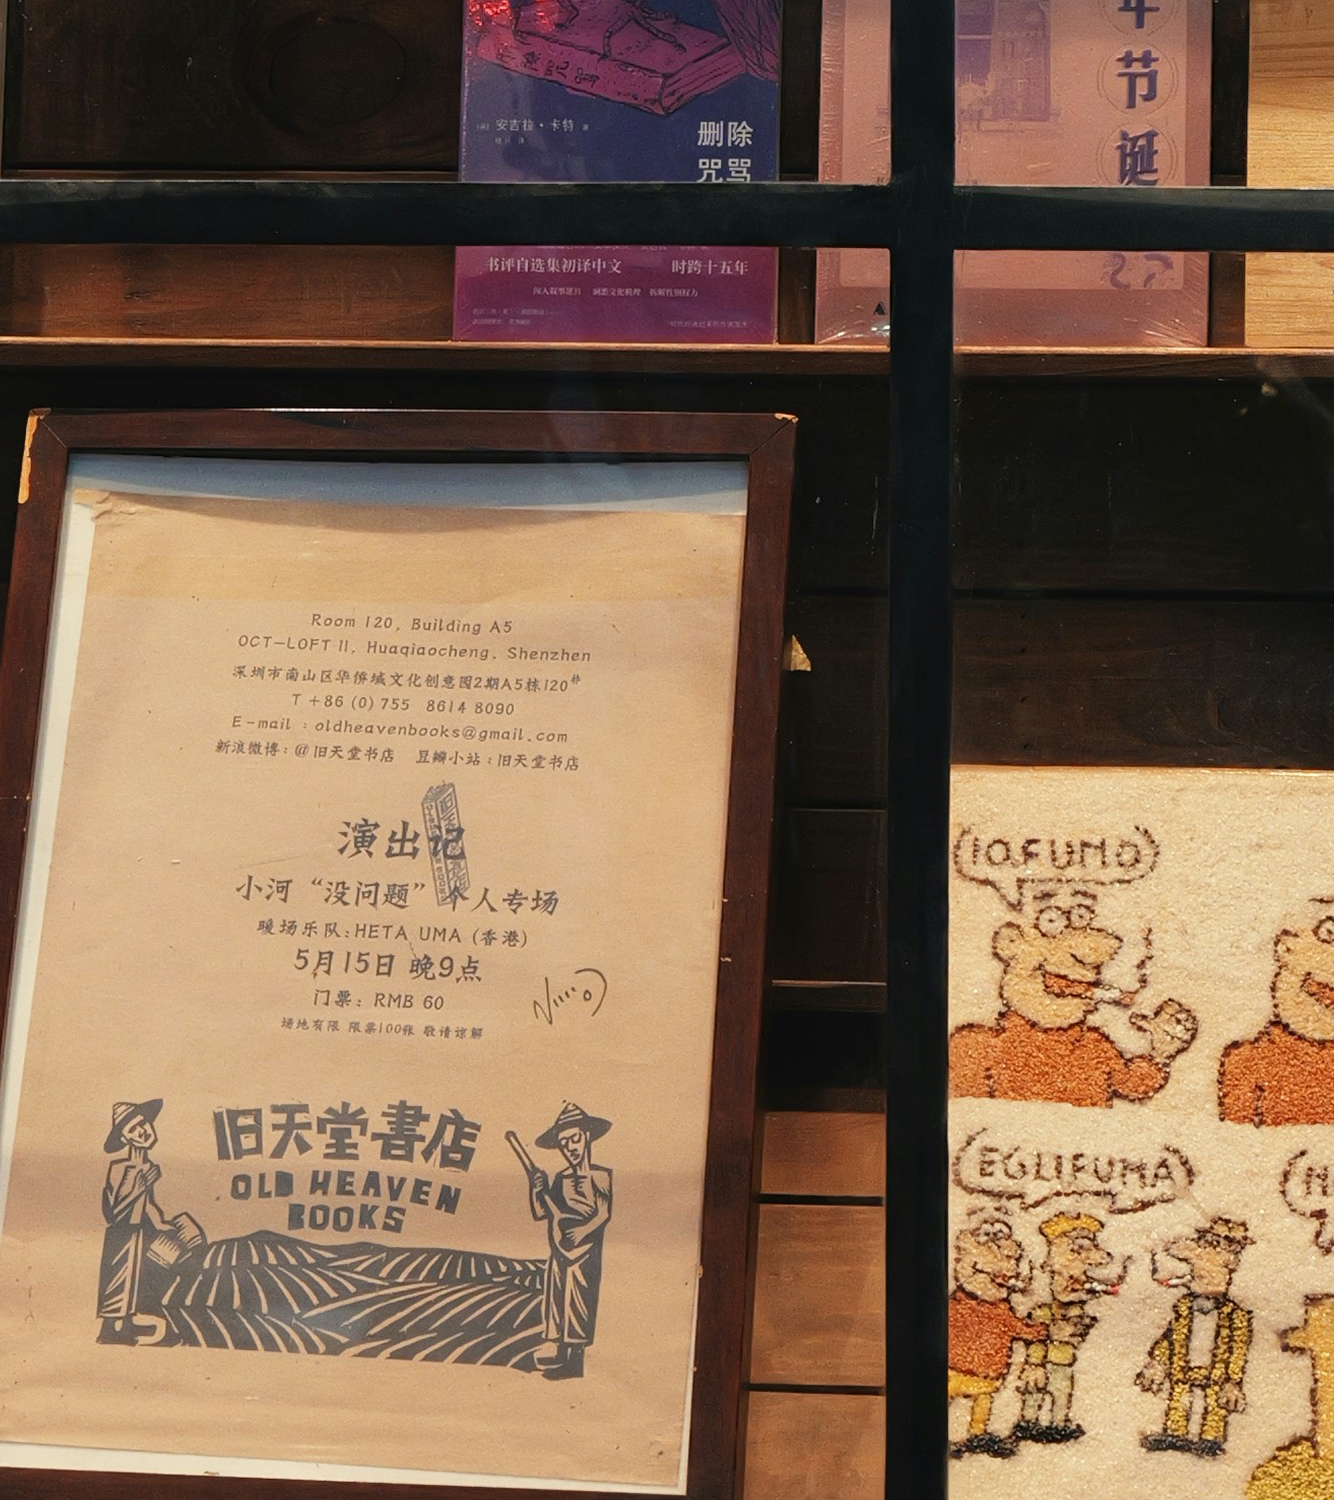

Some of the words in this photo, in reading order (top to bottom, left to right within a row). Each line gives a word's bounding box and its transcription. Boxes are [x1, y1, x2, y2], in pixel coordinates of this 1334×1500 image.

[495, 117, 575, 133] 安吉拉·卡特
[697, 120, 754, 148] 删除
[487, 256, 623, 275] 书评自选集初译中文
[670, 257, 750, 275] 时跨十五年
[311, 612, 356, 630] Room
[411, 616, 483, 636] Building
[489, 619, 513, 635] A5
[507, 645, 592, 664] Shenzhen
[292, 693, 302, 709] T
[308, 694, 345, 710] +86
[350, 695, 375, 711] (0)
[378, 696, 411, 712] 755
[426, 698, 468, 715] 8614
[474, 700, 515, 717] 8090
[314, 719, 568, 745] oldheavenbooks@gmail.com
[337, 816, 467, 863] 演出记
[234, 874, 294, 905] 小河
[446, 881, 560, 917] 个人专场
[353, 922, 408, 943] HETA
[418, 924, 463, 945] UMA
[292, 947, 396, 979] 5月15日
[409, 954, 483, 985] 晚9点
[373, 992, 415, 1010] RMB
[422, 994, 445, 1011] 60
[212, 1099, 482, 1173] 旧天堂書店
[230, 1169, 295, 1201] OLD
[309, 1168, 463, 1216] HEAVEN
[286, 1201, 408, 1235] BOOKS
